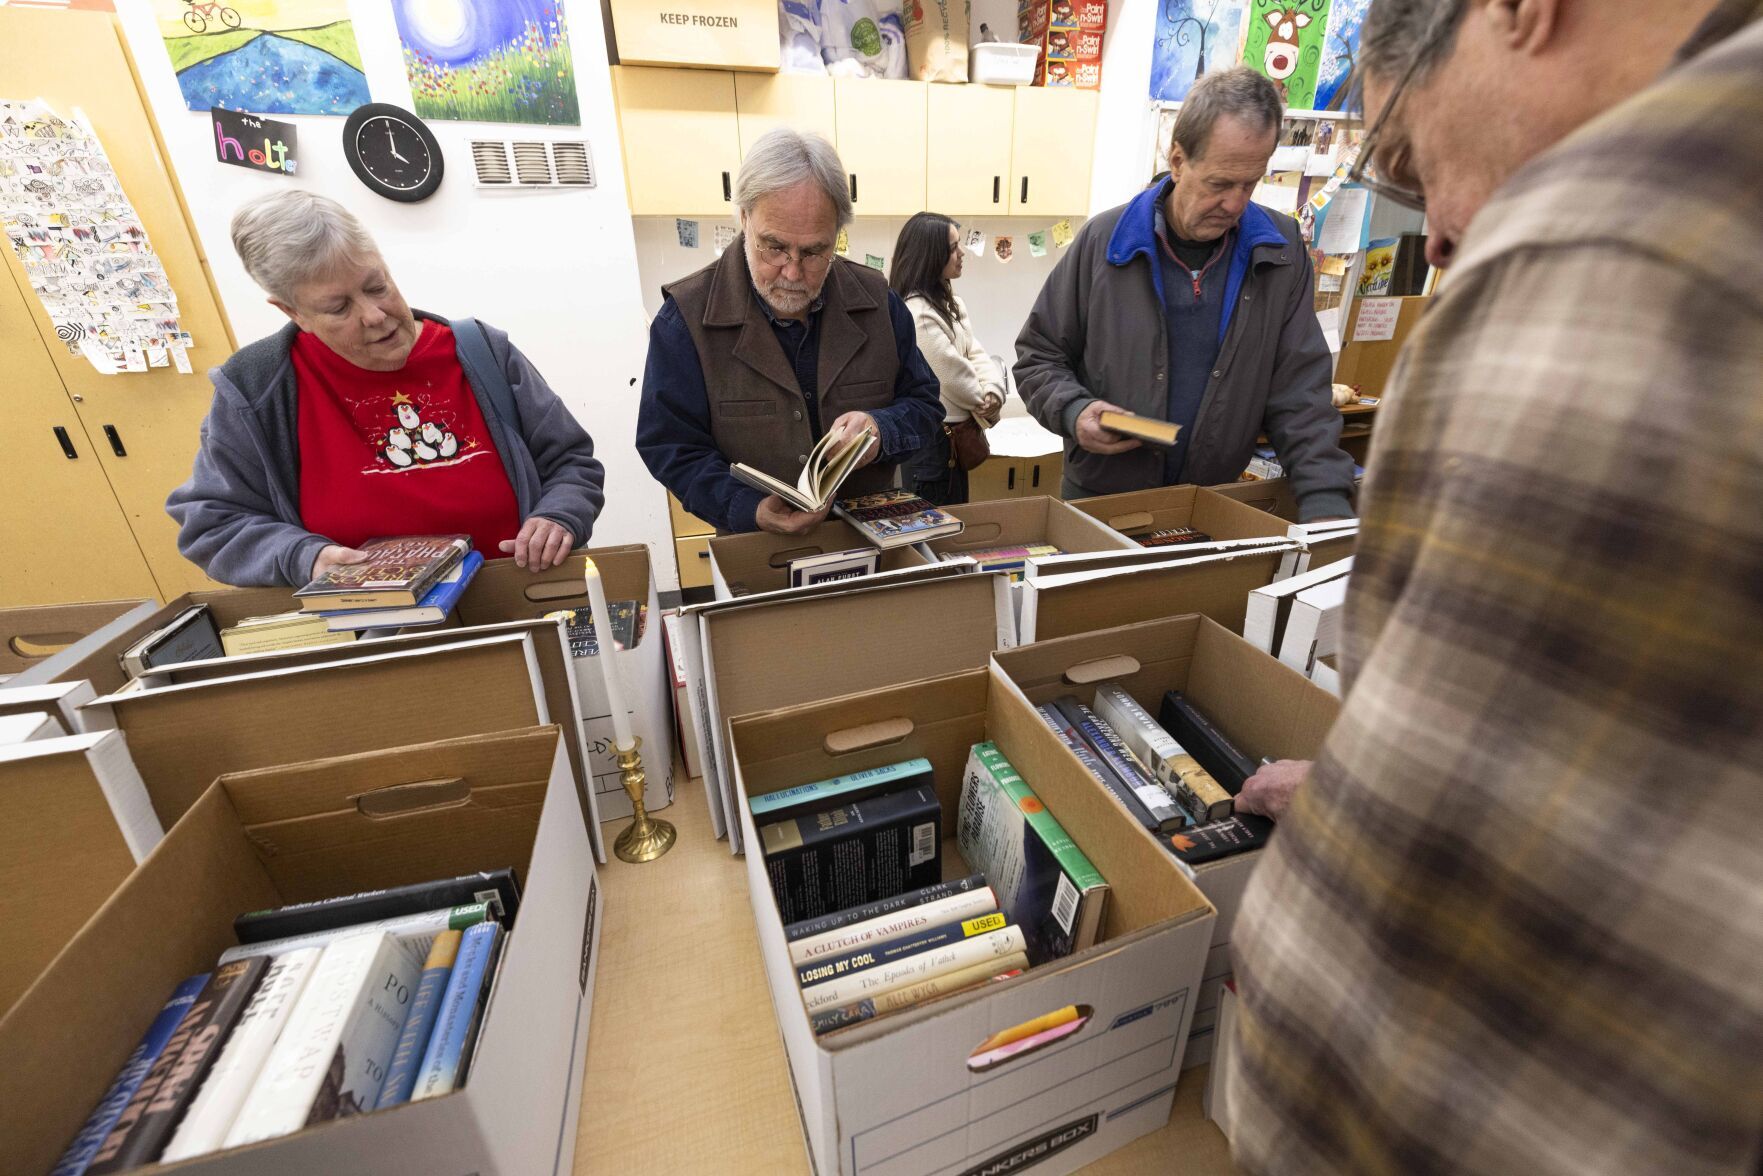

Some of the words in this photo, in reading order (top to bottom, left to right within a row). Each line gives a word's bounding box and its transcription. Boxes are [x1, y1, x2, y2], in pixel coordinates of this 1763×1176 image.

[1087, 3, 1105, 13] Paint
[660, 12, 690, 25] KEEP
[692, 15, 738, 28] FROZEN
[1082, 35, 1100, 45] Paint
[241, 117, 262, 128] the
[1113, 690, 1134, 708] JOHN
[762, 784, 819, 803] HALLUCINATIONS
[850, 771, 874, 782] OLIVER
[875, 765, 898, 776] SACKS
[919, 890, 953, 905] STRAND
[920, 883, 948, 896] CLARK
[454, 903, 483, 916] USED
[791, 920, 828, 937] WAKING
[831, 916, 843, 926] UP
[847, 912, 858, 921] TO
[862, 906, 880, 917] THE
[884, 899, 906, 912] DARK
[804, 947, 813, 959] A
[813, 933, 860, 956] CLUTCH
[860, 929, 874, 942] OF
[875, 916, 928, 938] VAMPIRES
[800, 963, 835, 984] LOSING
[835, 959, 851, 973] MY
[851, 952, 876, 968] COOL
[971, 916, 1001, 931] USED
[807, 991, 839, 1010] eckford
[859, 977, 881, 990] The
[883, 966, 915, 984] Episodes
[930, 951, 957, 968] Vathek
[142, 1023, 220, 1115] PARIS
[970, 1141, 1048, 1176] NKERS
[1050, 1122, 1090, 1148] BOX
